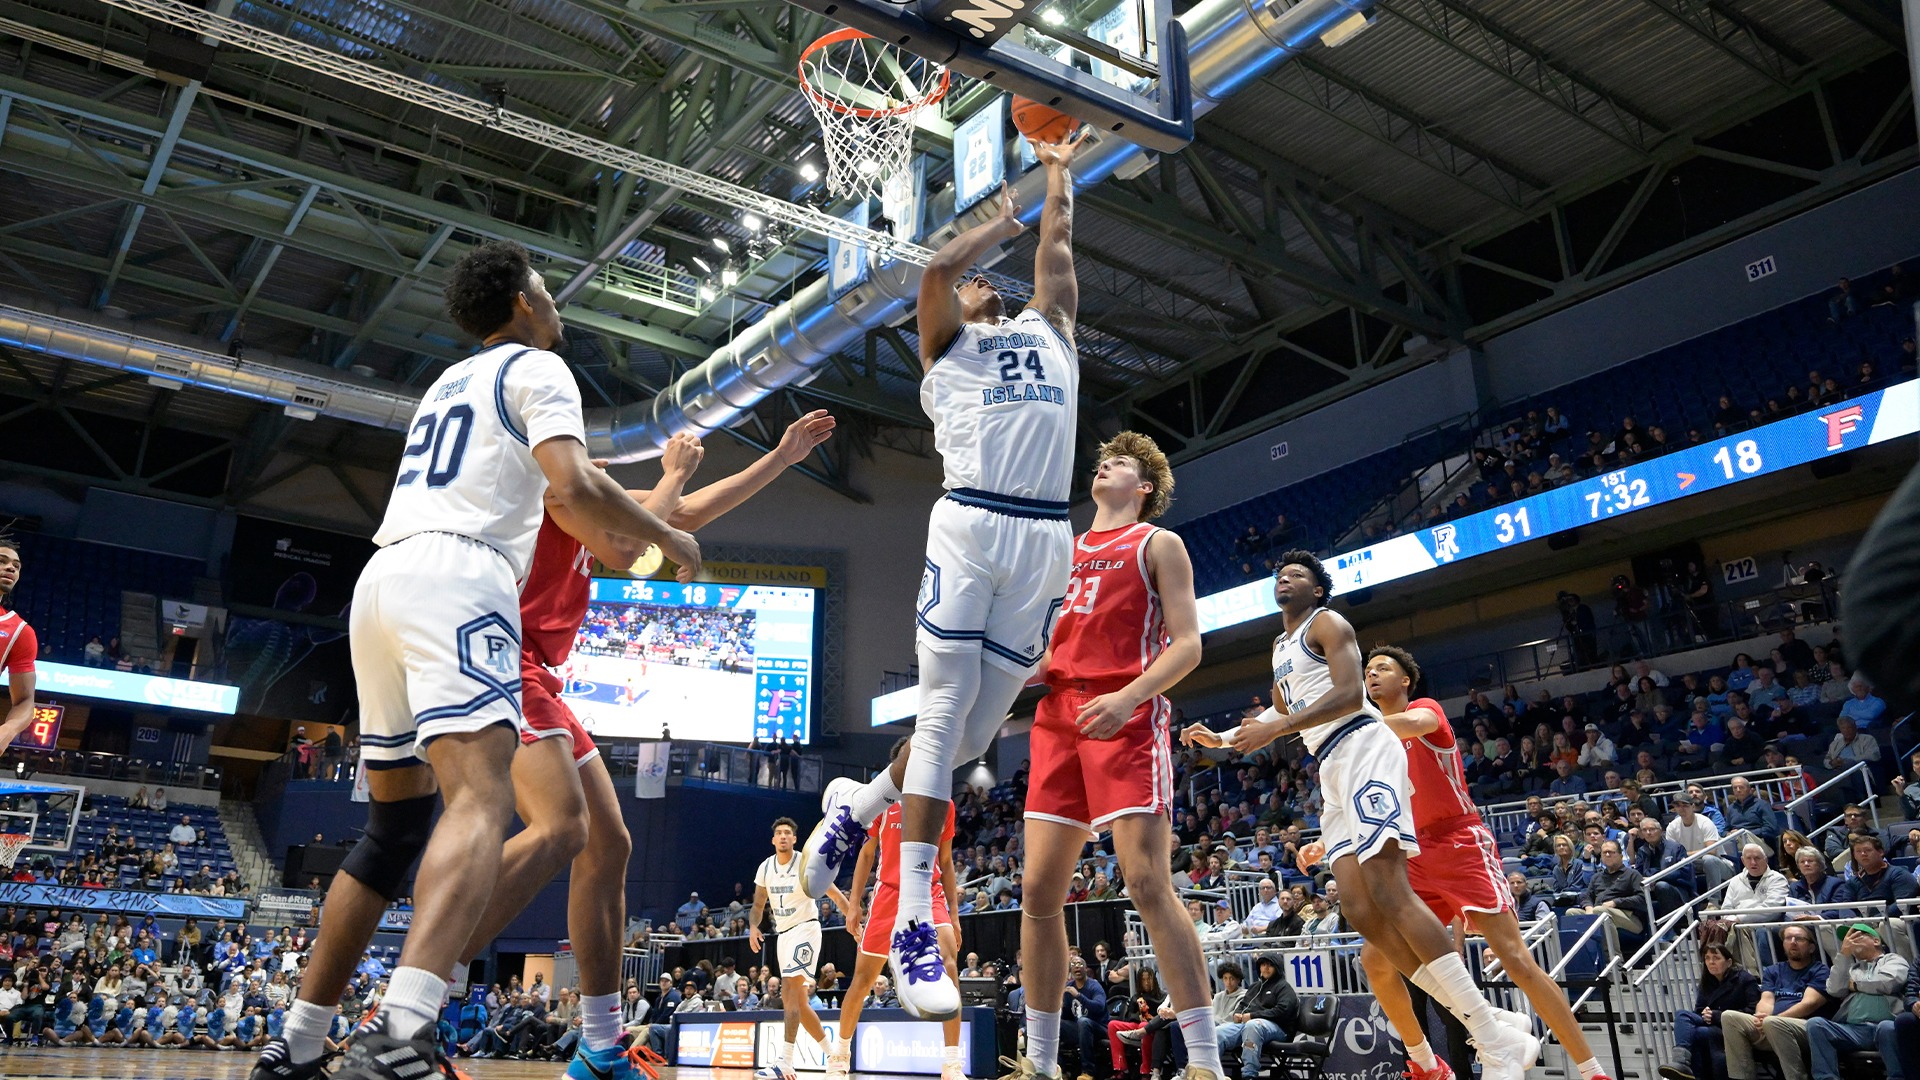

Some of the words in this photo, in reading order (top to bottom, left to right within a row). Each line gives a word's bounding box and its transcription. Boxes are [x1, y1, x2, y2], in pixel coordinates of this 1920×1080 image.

[969, 151, 987, 180] 22
[843, 249, 851, 270] 3
[1749, 258, 1773, 279] 311
[978, 332, 1050, 354] RHODE
[997, 349, 1046, 383] 24
[983, 383, 1065, 406] ISLAND
[396, 402, 477, 490] 20
[1271, 443, 1287, 459] 310
[1713, 439, 1763, 480] 18
[1600, 470, 1627, 489] 1ST
[1585, 478, 1651, 520] 7:32
[1495, 506, 1532, 544] 31
[711, 562, 749, 579] HODE
[755, 568, 812, 584] ISLAND
[1354, 569, 1363, 585] 4
[1725, 559, 1757, 582] 212
[682, 584, 707, 606] 18
[1280, 679, 1293, 706] 11
[34, 722, 50, 745] 9
[137, 729, 159, 741] 209
[42, 885, 97, 907] RAMS
[107, 891, 162, 910] RAMS
[260, 893, 287, 903] Clean
[294, 895, 313, 905] Rite
[780, 895, 784, 909] 1
[1290, 955, 1324, 988] 111
[911, 1040, 940, 1058] Rhode
